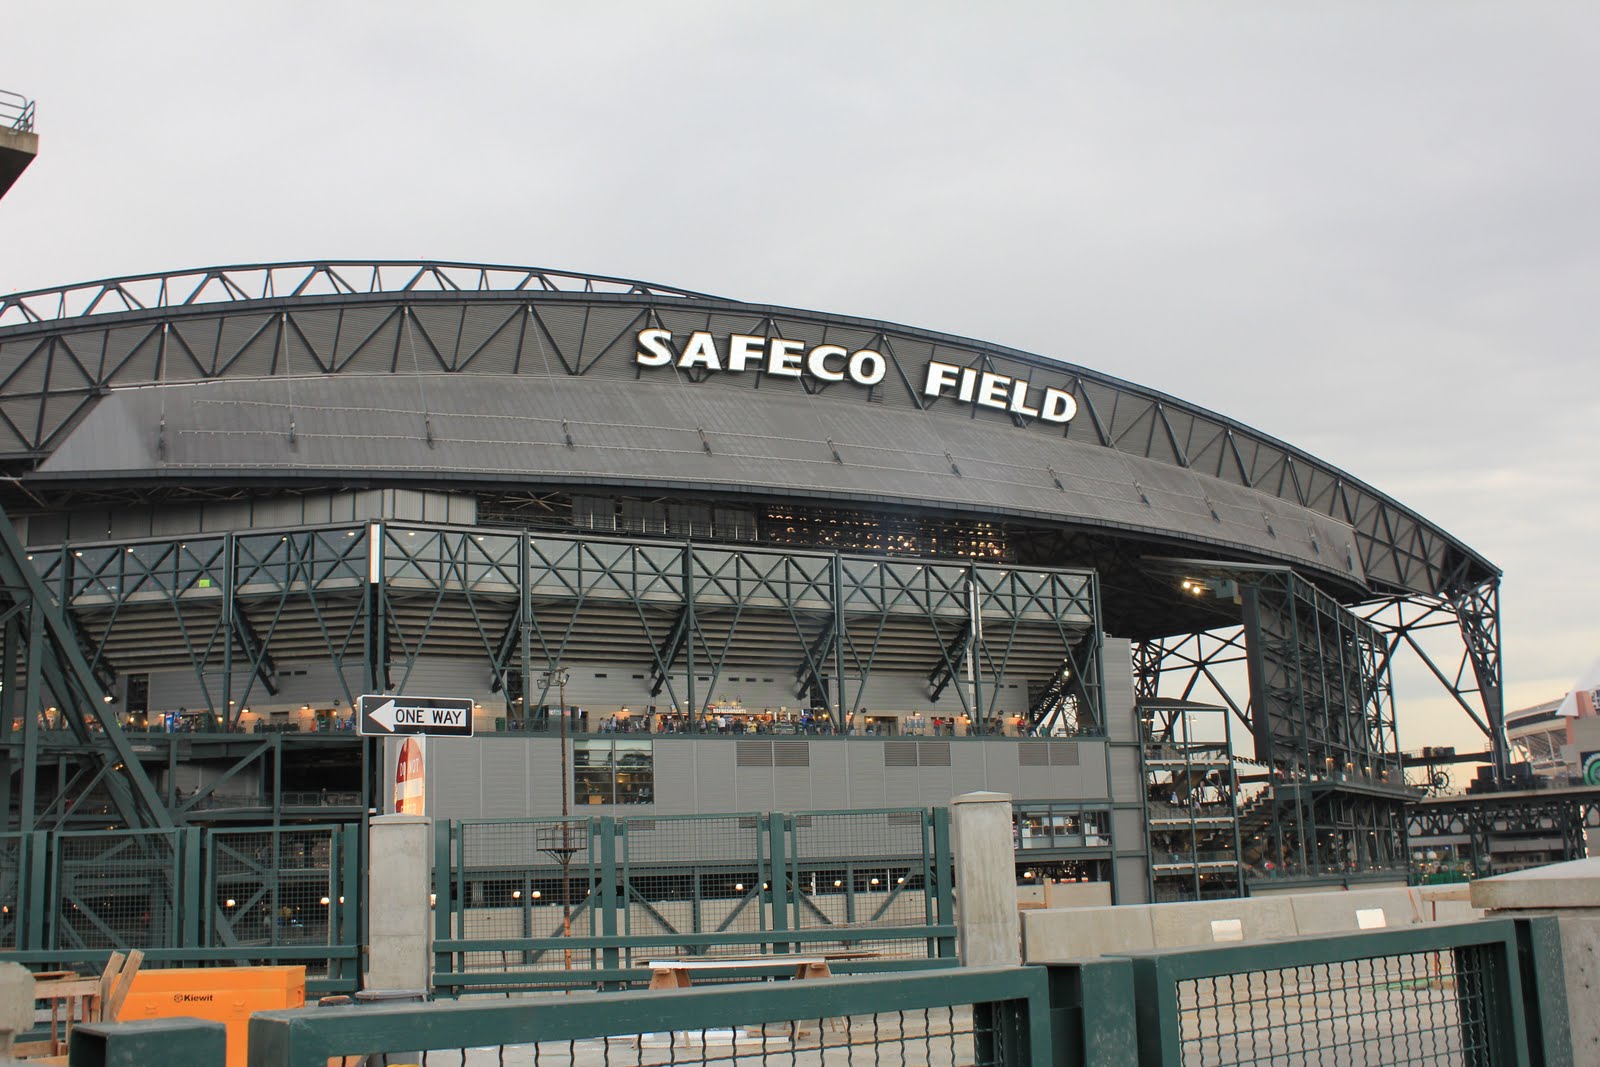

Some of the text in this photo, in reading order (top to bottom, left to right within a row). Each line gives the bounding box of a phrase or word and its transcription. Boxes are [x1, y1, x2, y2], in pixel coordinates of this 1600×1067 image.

[636, 328, 1078, 423] SAFECO FIELD
[396, 709, 462, 724] ONE WAY
[184, 994, 213, 1002] Kiewit
